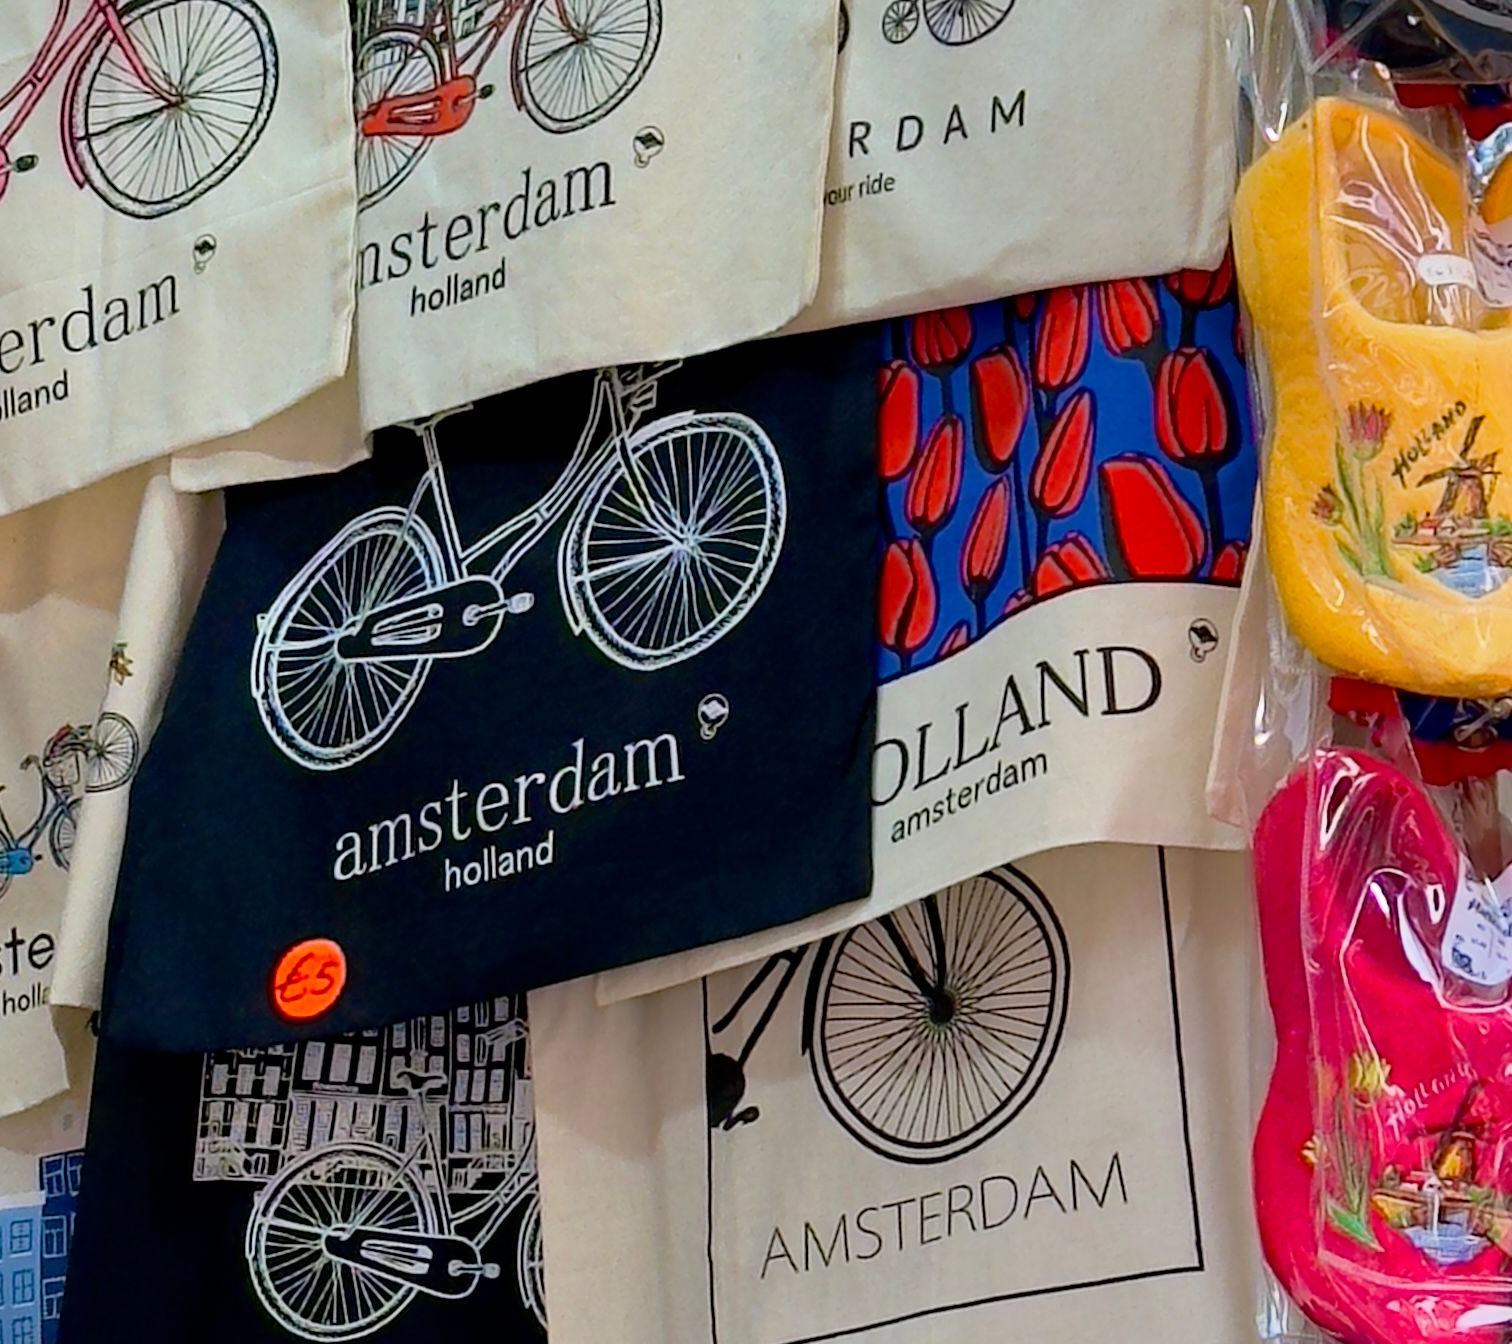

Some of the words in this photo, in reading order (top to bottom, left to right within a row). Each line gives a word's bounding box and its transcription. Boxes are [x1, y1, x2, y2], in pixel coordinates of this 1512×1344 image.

[358, 156, 616, 288] msterdam
[858, 173, 895, 197] ride
[410, 258, 507, 317] holland
[871, 647, 1162, 808] OLLAND
[334, 732, 684, 881] amsterdam
[890, 752, 1048, 843] amsterdam
[444, 832, 554, 892] holland
[2, 984, 49, 1016] holl
[762, 1153, 1127, 1279] AMSTERDAM
